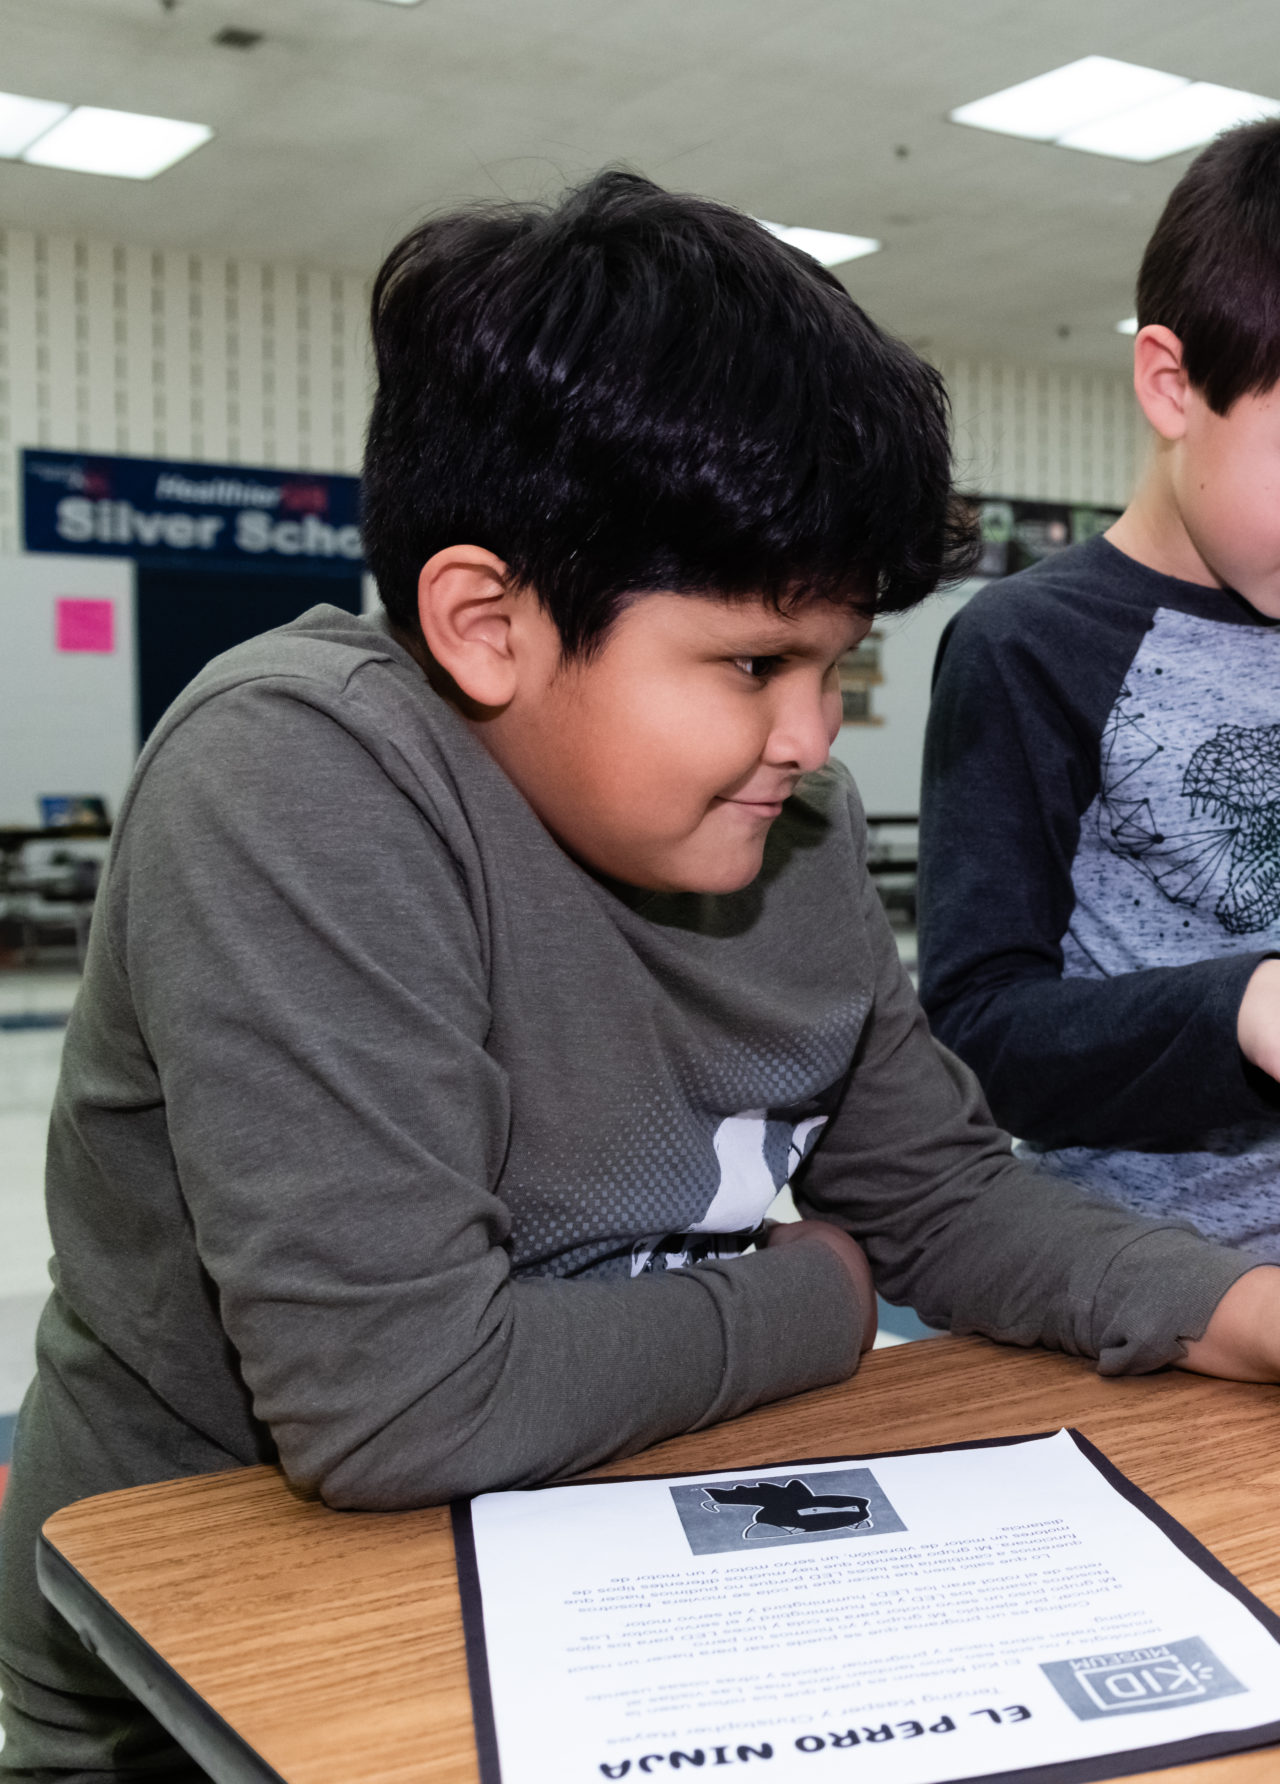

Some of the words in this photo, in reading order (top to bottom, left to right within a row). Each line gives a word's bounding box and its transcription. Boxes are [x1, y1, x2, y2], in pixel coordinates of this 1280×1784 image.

[57, 497, 224, 549] Silver
[1069, 1646, 1171, 1671] MUSEUM
[1104, 1663, 1198, 1698] KID
[970, 1704, 1032, 1725] EL
[794, 1714, 958, 1753] PERRO
[599, 1742, 774, 1780] NINJA
